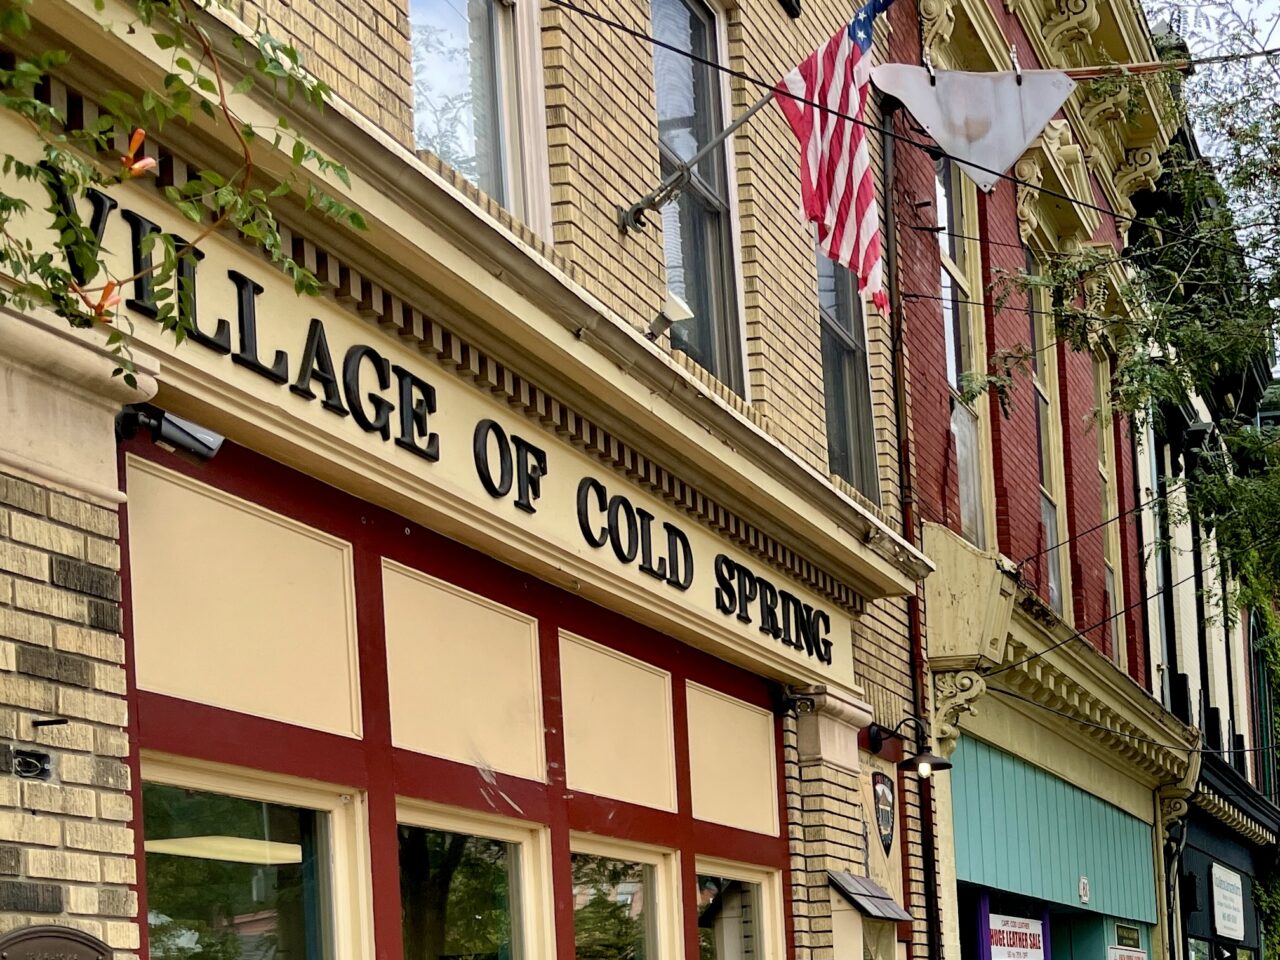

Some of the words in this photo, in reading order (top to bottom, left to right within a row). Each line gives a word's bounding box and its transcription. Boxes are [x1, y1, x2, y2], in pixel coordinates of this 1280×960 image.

[38, 159, 441, 463] VILLAGE
[473, 418, 548, 514] OF
[576, 476, 694, 591] COLD
[714, 553, 834, 666] SPRING
[989, 929, 1006, 948] HUGE
[1006, 930, 1029, 949] LEATHER
[1029, 932, 1041, 950] SALE
